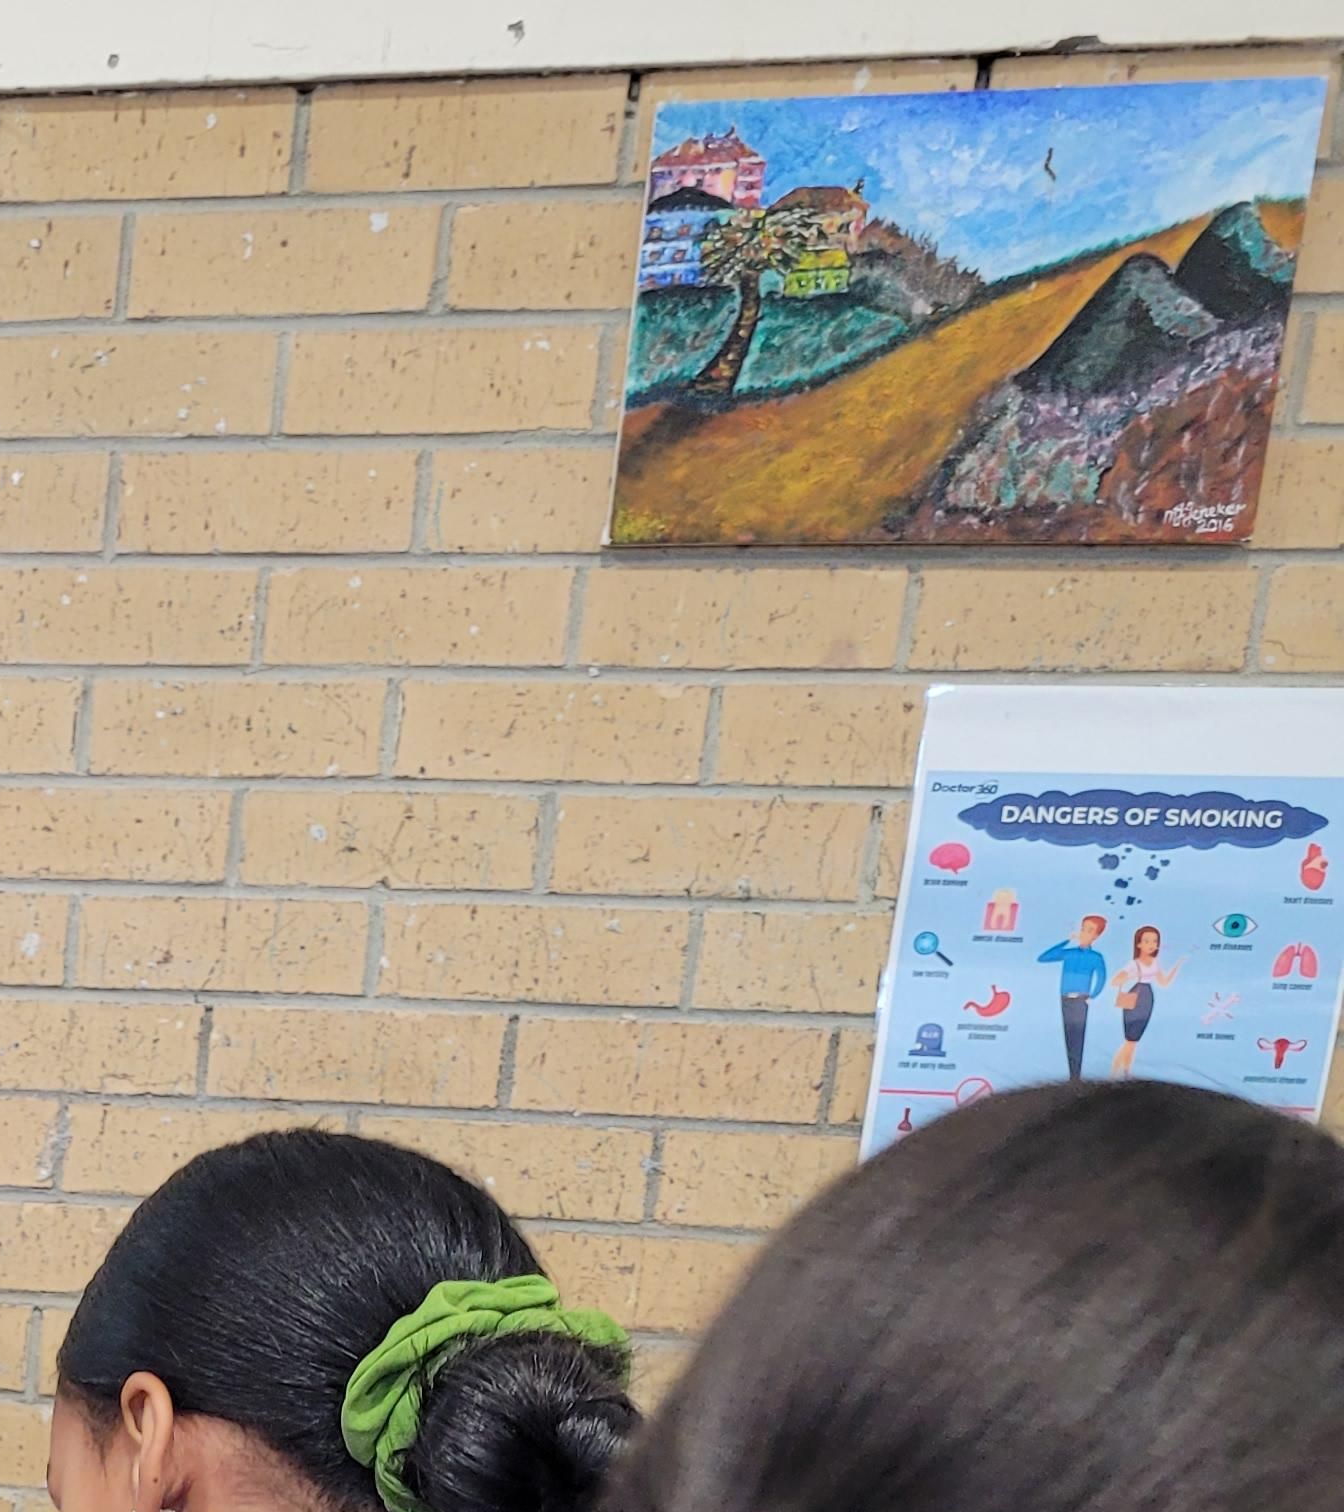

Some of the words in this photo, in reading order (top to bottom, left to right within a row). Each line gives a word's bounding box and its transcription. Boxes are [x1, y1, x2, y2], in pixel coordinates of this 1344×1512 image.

[1195, 518, 1234, 533] 2016
[1000, 804, 1119, 825] DANGERS
[1124, 807, 1161, 826] OF
[1164, 808, 1283, 829] SMOKING
